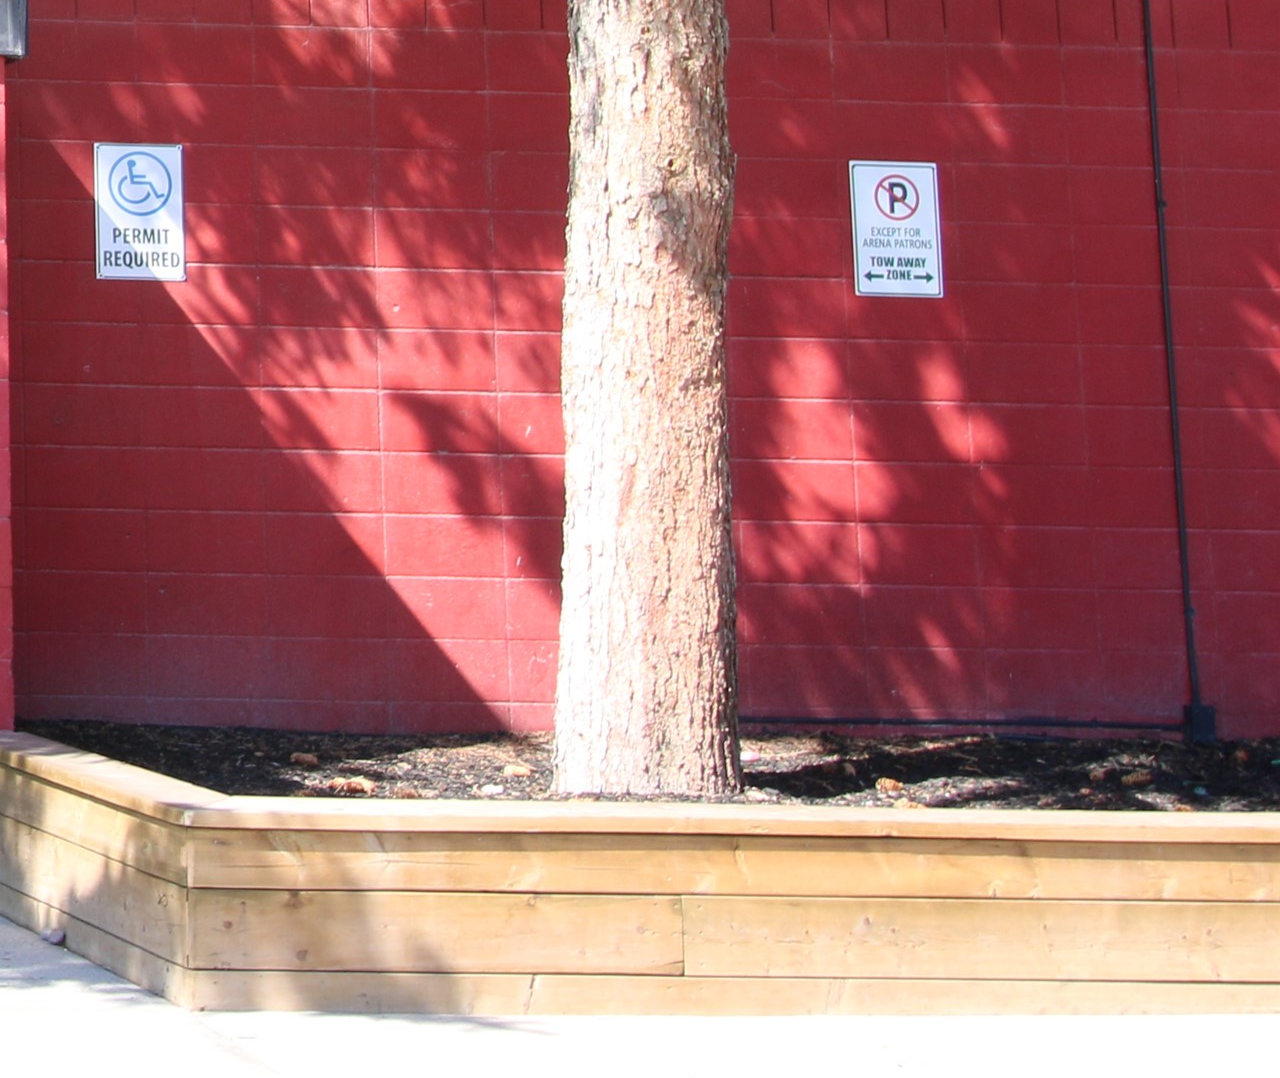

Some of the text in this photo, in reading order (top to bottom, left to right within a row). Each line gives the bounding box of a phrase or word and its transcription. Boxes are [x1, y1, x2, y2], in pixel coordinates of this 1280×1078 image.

[887, 181, 908, 214] P
[113, 227, 170, 244] PERMIT
[871, 226, 921, 237] EXCEPT FOR
[862, 238, 933, 250] ARENA PATRONS
[103, 250, 180, 269] REQUIRED
[870, 256, 927, 269] TOW AWAY
[886, 269, 912, 280] ZONE
